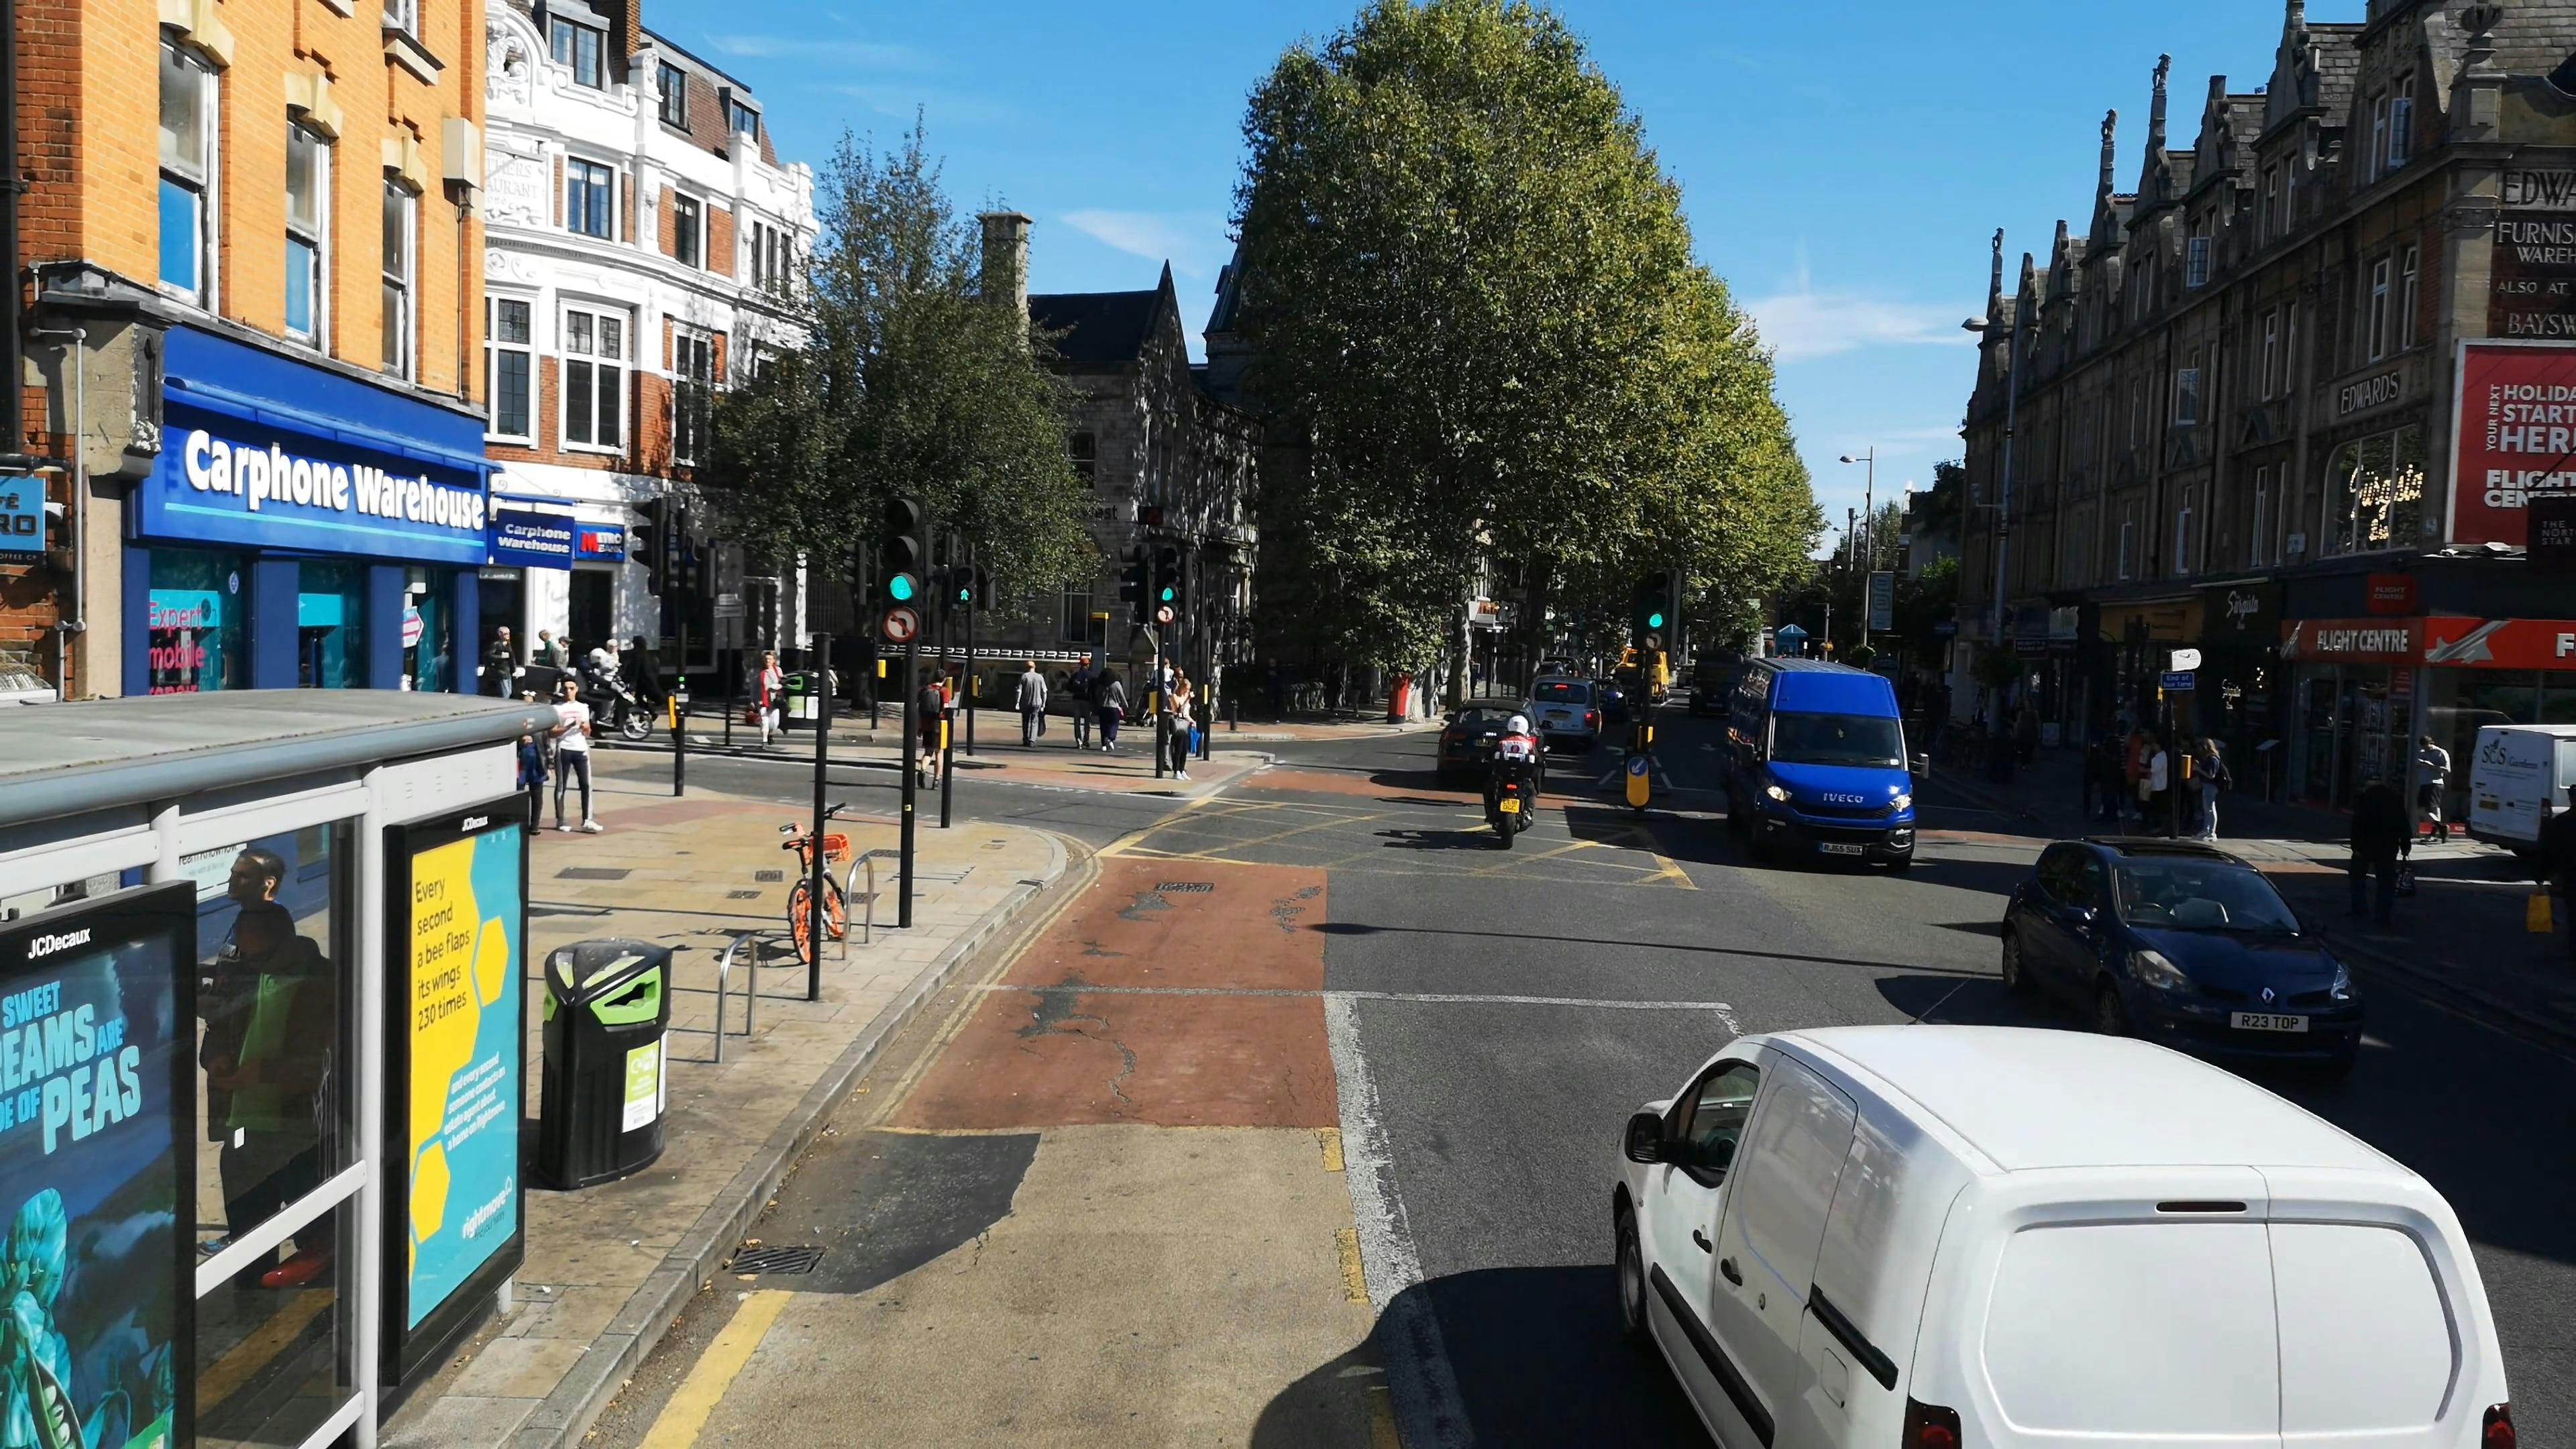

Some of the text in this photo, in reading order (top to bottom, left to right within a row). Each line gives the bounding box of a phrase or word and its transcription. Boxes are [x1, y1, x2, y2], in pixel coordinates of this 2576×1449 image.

[2497, 281, 2569, 294] ALSO AT
[2486, 384, 2501, 451] YOUR NEXT
[2500, 426, 2576, 453] HER
[185, 429, 484, 531] Carphone Warehouse
[505, 523, 571, 541] Carphone
[2542, 520, 2566, 529] THE
[498, 536, 570, 553] Warehouse
[580, 531, 623, 553] METRO
[598, 543, 623, 553] BANK
[2541, 537, 2571, 545] STAR
[150, 601, 203, 637] Expert
[150, 639, 205, 669] mobile
[2317, 629, 2408, 653] FLIGHT CENTRE
[2556, 633, 2576, 657] F
[1823, 793, 1864, 804] IVECO
[415, 877, 445, 903] Every
[417, 905, 453, 936] second
[28, 928, 91, 960] JCDecaux
[417, 928, 470, 969] a bee flaps
[417, 963, 461, 1002] its wings
[3, 980, 61, 1028] SWEET
[418, 991, 467, 1032] 230 times
[2242, 1015, 2299, 1029] R23 TOP
[0, 1004, 124, 1095] EAMS ARE
[18, 1086, 40, 1123] OF
[43, 1045, 142, 1155] PEAS
[462, 1189, 506, 1239] rightmove
